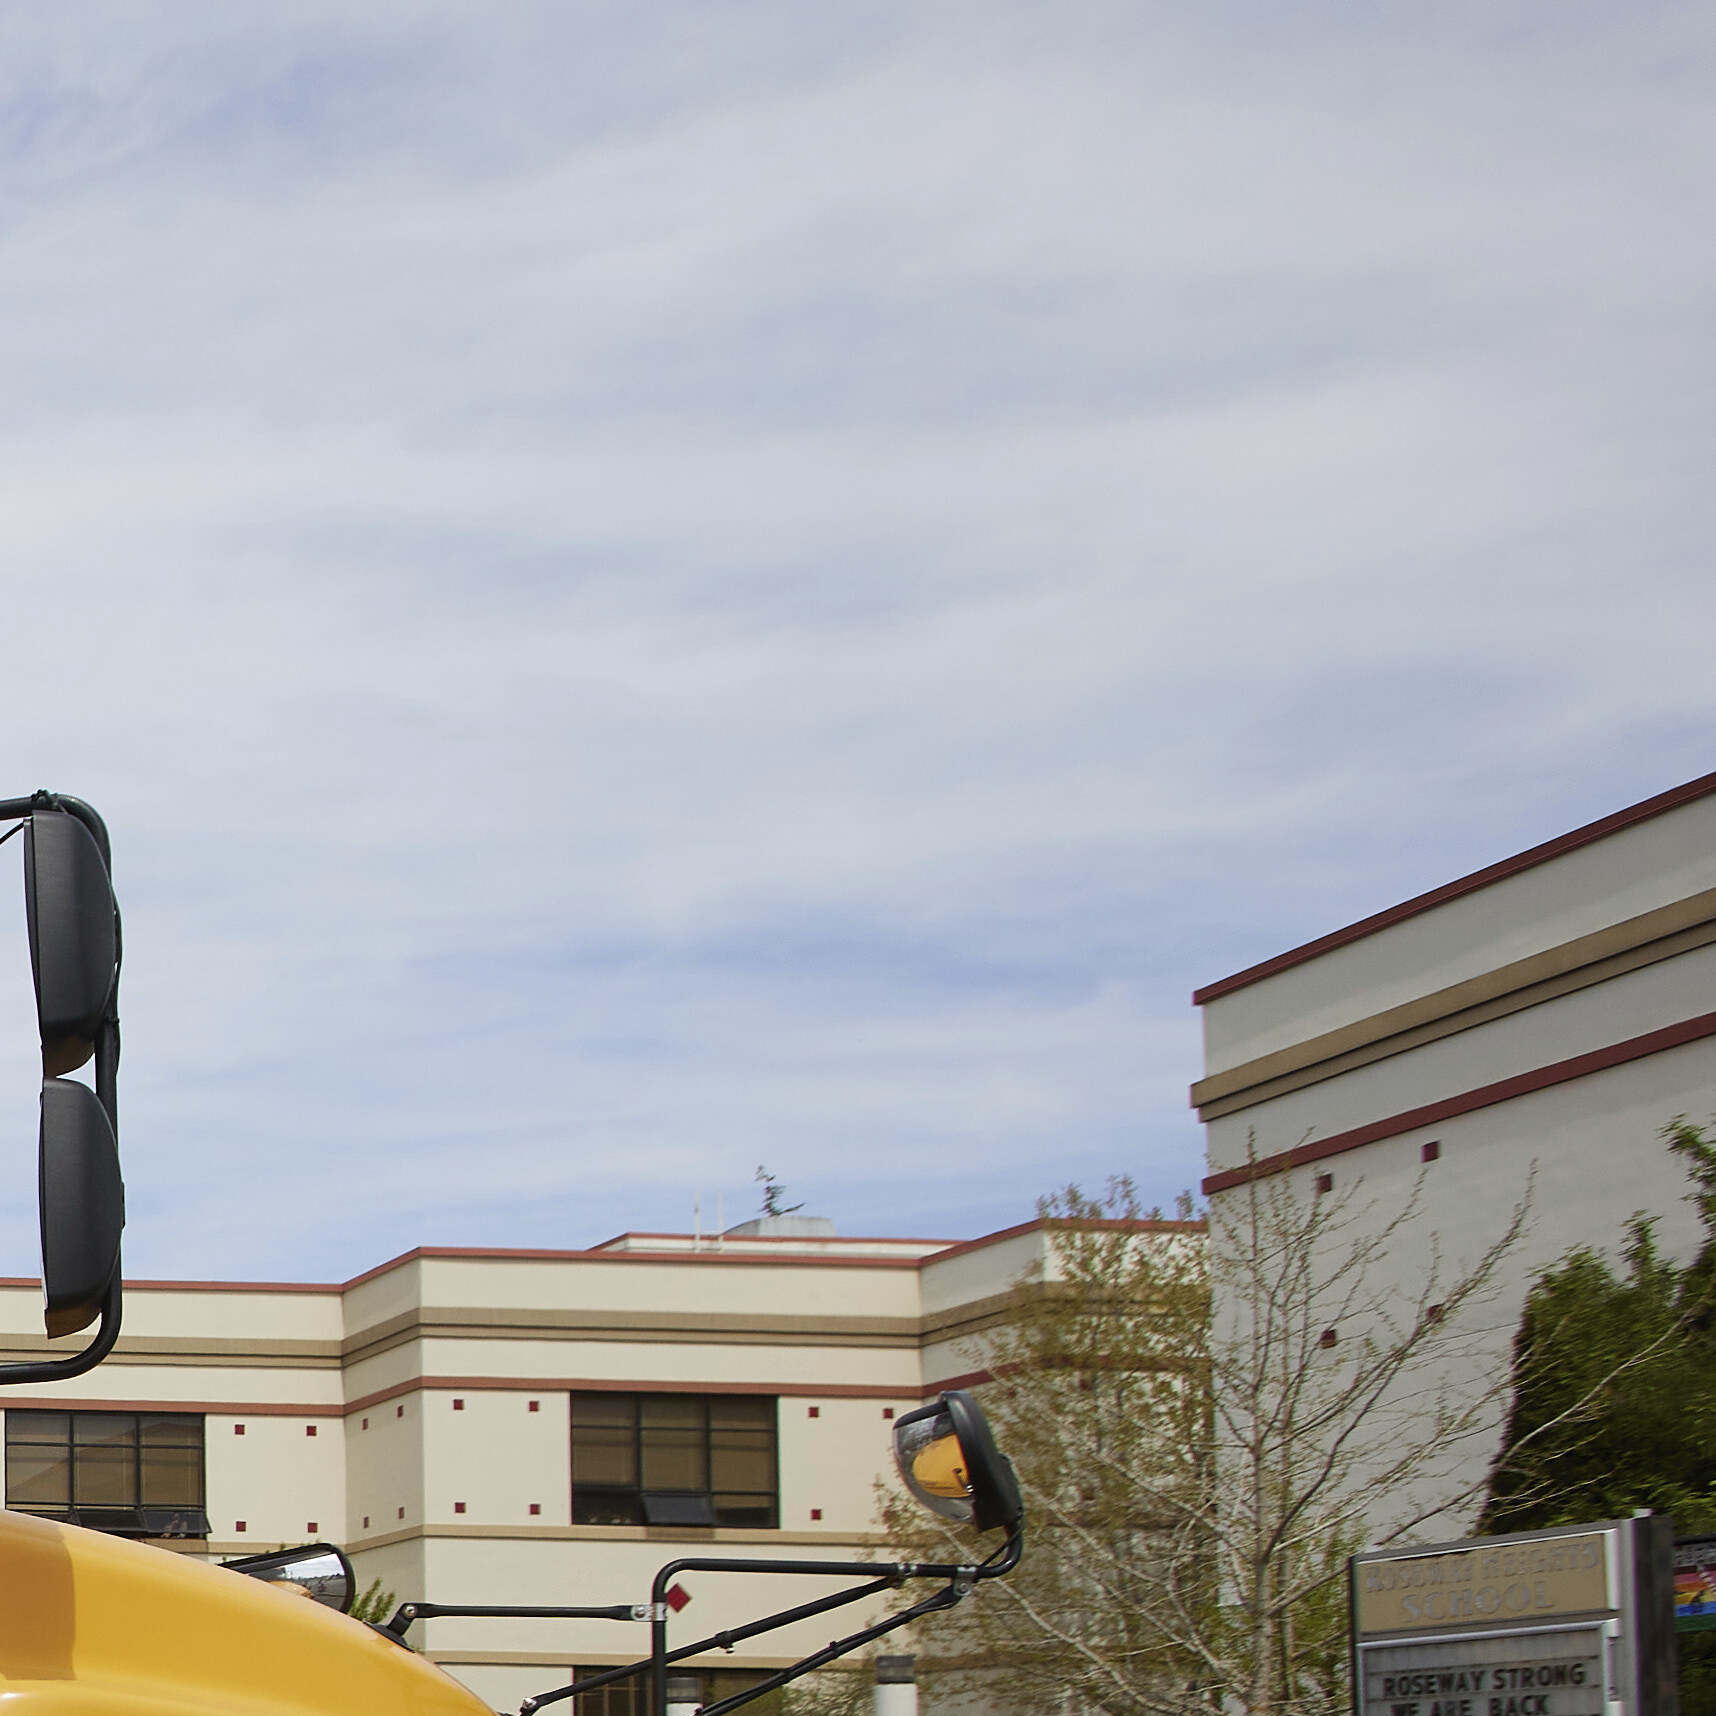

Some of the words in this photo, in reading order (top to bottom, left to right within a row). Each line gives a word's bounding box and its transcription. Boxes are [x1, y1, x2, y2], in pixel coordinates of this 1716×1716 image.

[1399, 1579, 1555, 1623] SCHOOL
[1382, 1668, 1485, 1698] ROSEWAY
[1491, 1662, 1587, 1691] STRONG
